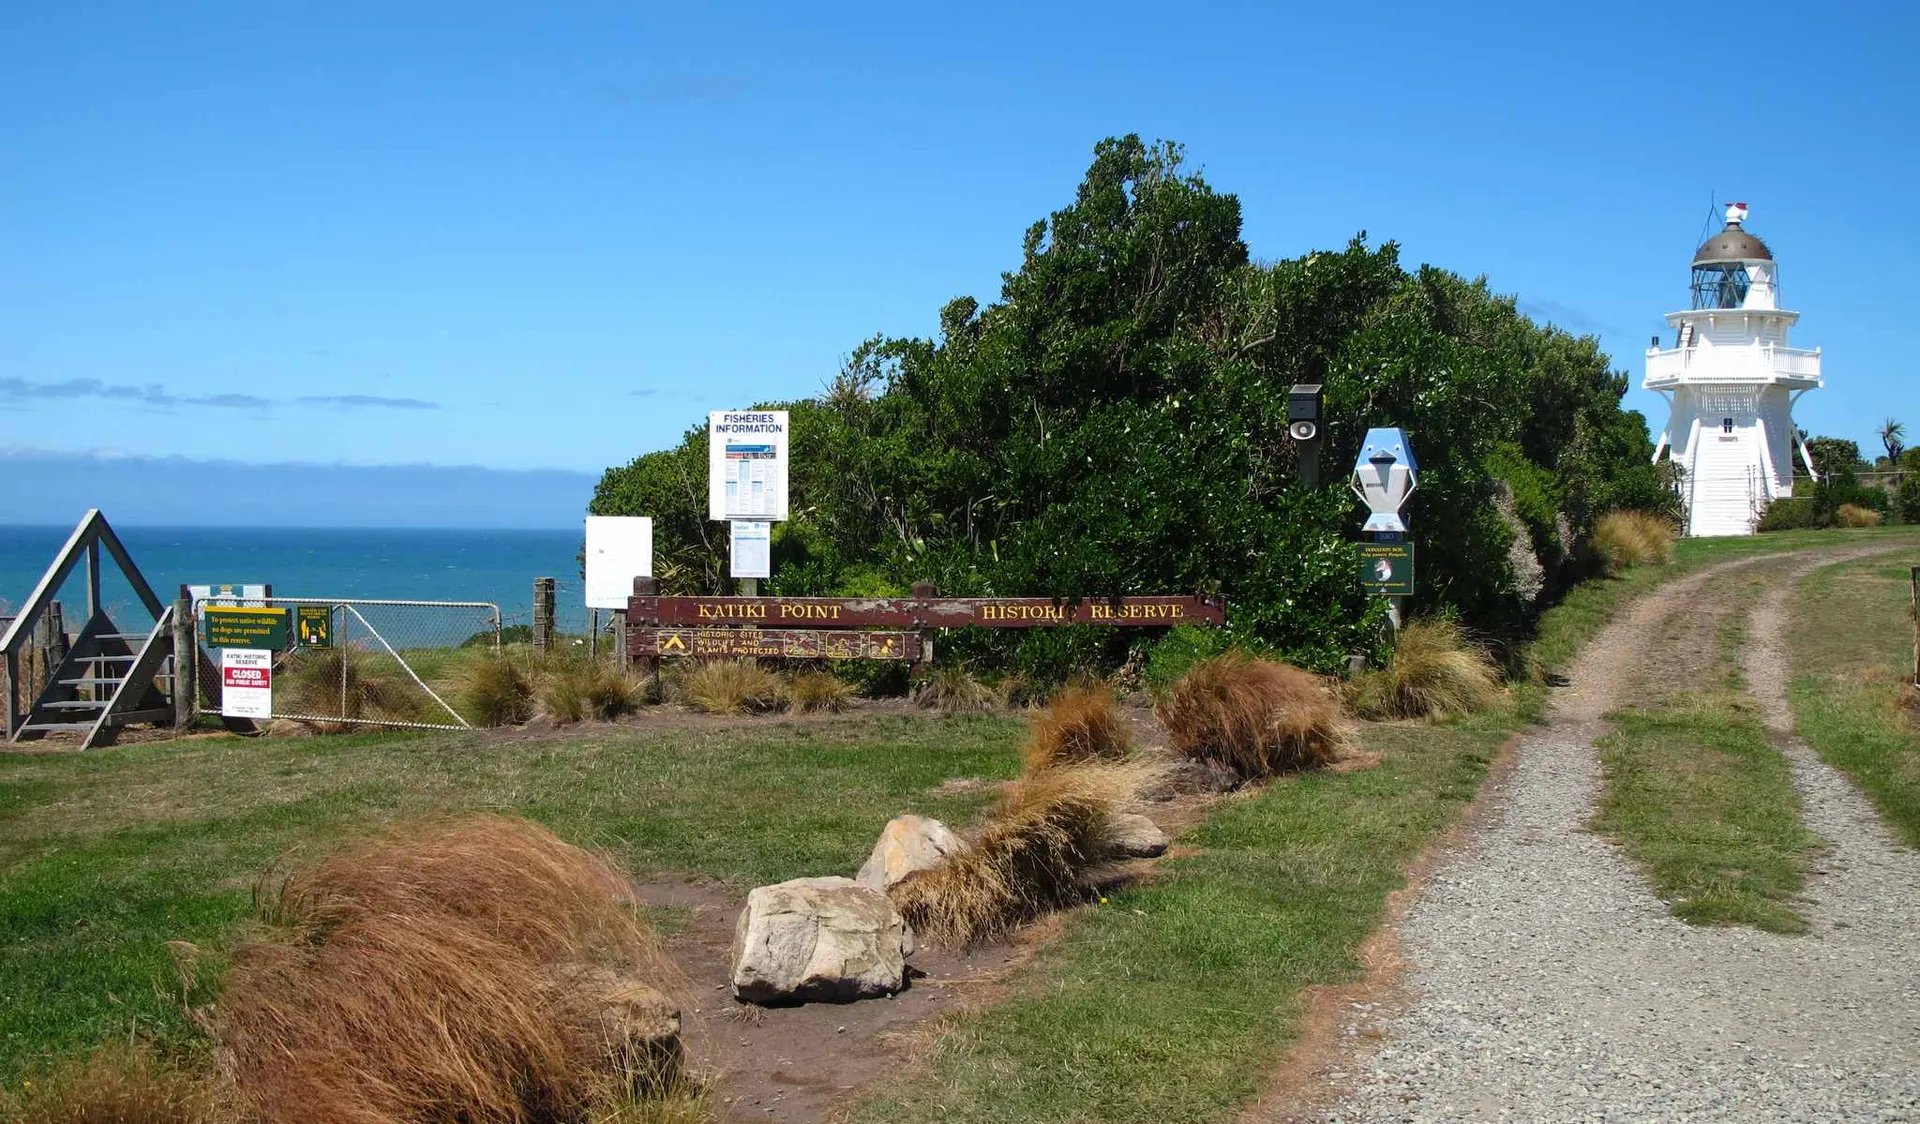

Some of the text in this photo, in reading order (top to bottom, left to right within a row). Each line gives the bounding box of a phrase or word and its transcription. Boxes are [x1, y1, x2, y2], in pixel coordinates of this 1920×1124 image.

[724, 414, 774, 423] FISHERIES
[716, 424, 782, 433] INFORMATION
[698, 604, 767, 618] KATIKI
[780, 604, 842, 619] POINT
[1091, 604, 1184, 618] RESERVE
[220, 617, 239, 625] protect
[257, 617, 278, 625] wildlife
[220, 626, 233, 634] dogs
[232, 669, 262, 679] CLOSED
